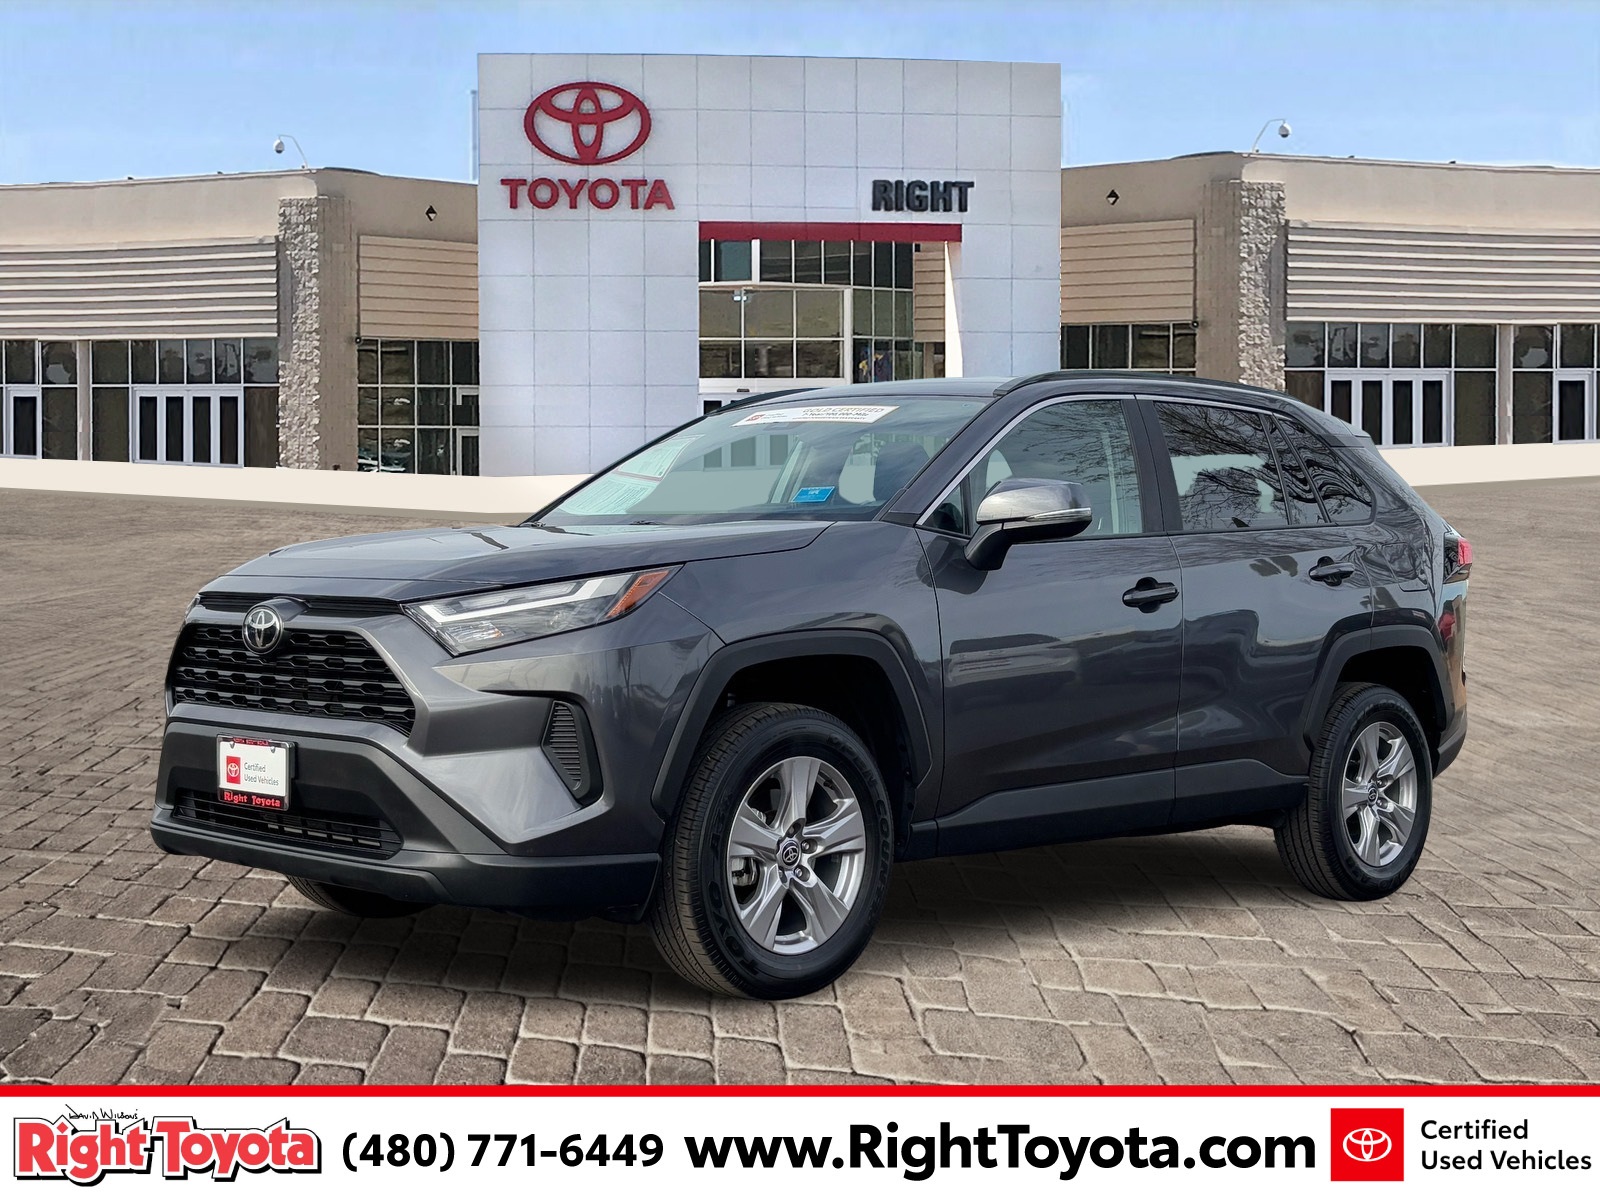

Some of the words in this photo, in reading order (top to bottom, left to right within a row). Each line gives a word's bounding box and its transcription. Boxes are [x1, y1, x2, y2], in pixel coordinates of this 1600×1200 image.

[501, 178, 675, 210] TOYOTA
[872, 179, 975, 212] RIGHT
[243, 762, 267, 773] Certified
[243, 774, 257, 783] Used
[258, 776, 280, 786] Vehicles
[223, 791, 248, 804] Right
[251, 795, 281, 807] Toyota
